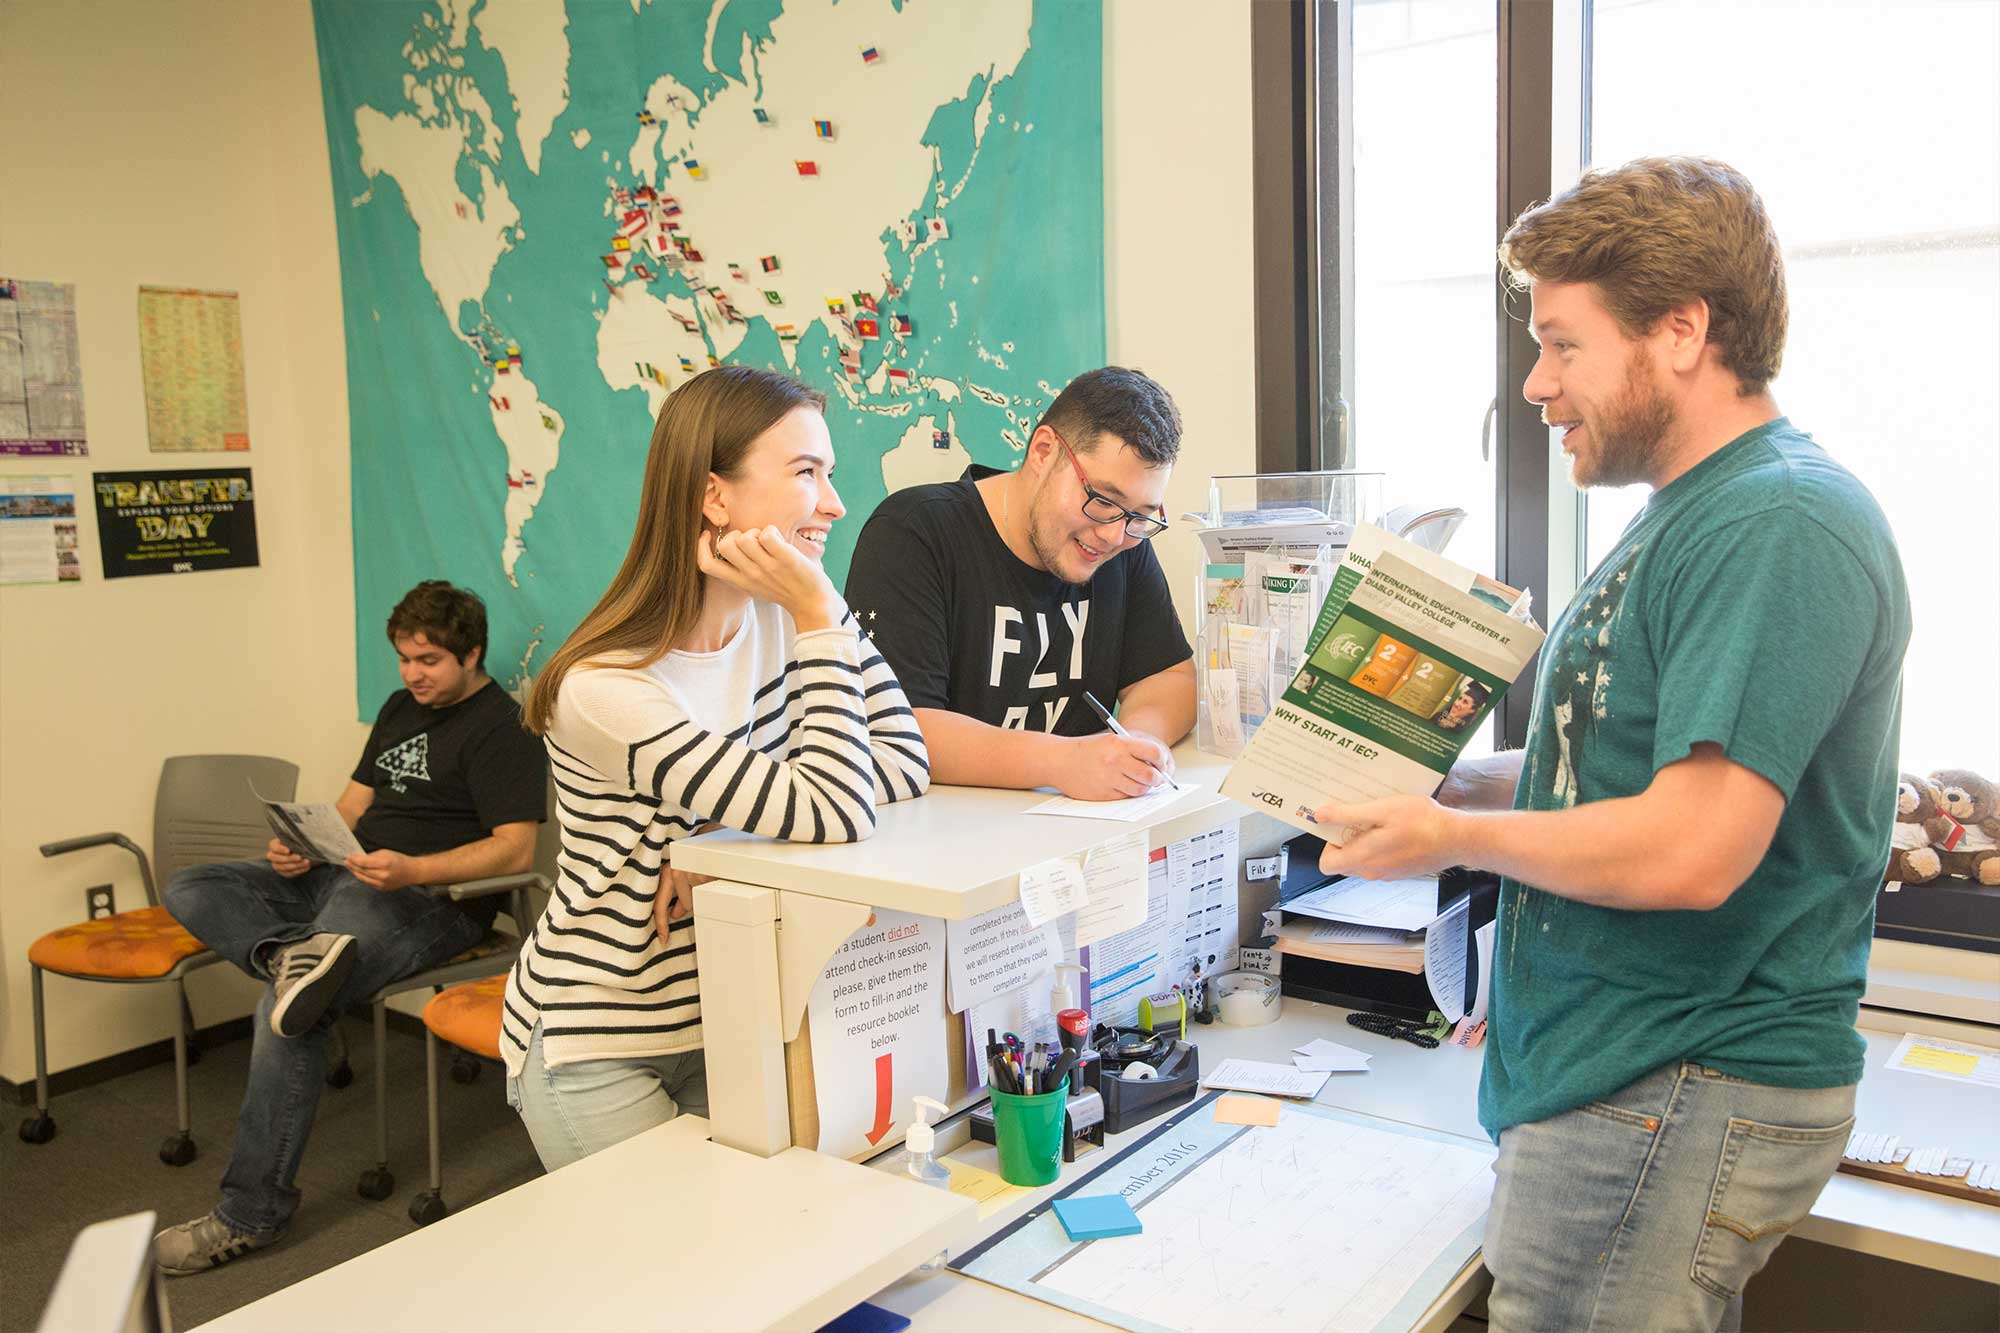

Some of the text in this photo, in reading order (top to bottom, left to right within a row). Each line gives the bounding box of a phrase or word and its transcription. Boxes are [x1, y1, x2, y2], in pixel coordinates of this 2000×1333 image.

[96, 477, 253, 507] TRANSFER
[136, 513, 214, 541] DAY
[1350, 552, 1375, 569] WHA
[1365, 578, 1456, 628] DIABLO VALLEY COLLEGE
[1371, 569, 1428, 603] INTERNATIONAL
[1430, 599, 1471, 624] EDUCATION
[1471, 621, 1500, 639] CENTER
[1499, 636, 1511, 644] AT
[990, 600, 1089, 688] FLY
[1379, 644, 1397, 661] 2
[1416, 662, 1434, 678] 2
[1275, 706, 1302, 724] WHY
[1302, 720, 1338, 742] START
[1337, 738, 1353, 749] AT
[1353, 743, 1379, 760] IEC?
[1262, 792, 1284, 808] CEA
[1251, 865, 1266, 875] File
[843, 943, 849, 953] a
[851, 933, 886, 951] student
[888, 927, 902, 941] did
[904, 923, 920, 936] not
[969, 917, 1001, 936] completed
[1002, 912, 1012, 923] the
[1005, 928, 1019, 939] they
[825, 960, 856, 980] attend
[858, 950, 896, 970] check-in
[897, 942, 931, 958] session,
[966, 961, 976, 971] we
[976, 955, 988, 967] will
[988, 948, 1010, 962] resend
[1010, 941, 1027, 954] email
[1028, 936, 1041, 949] with
[969, 948, 1048, 987] to them so that they could
[833, 961, 928, 1001] please, give them the
[992, 974, 1021, 992] complete
[835, 981, 928, 1020] form to fill-in and the
[1150, 992, 1177, 1002] COPY
[847, 1004, 920, 1037] resource booklet
[871, 1031, 900, 1049] below.
[1119, 1141, 1198, 1197] ember 2016
